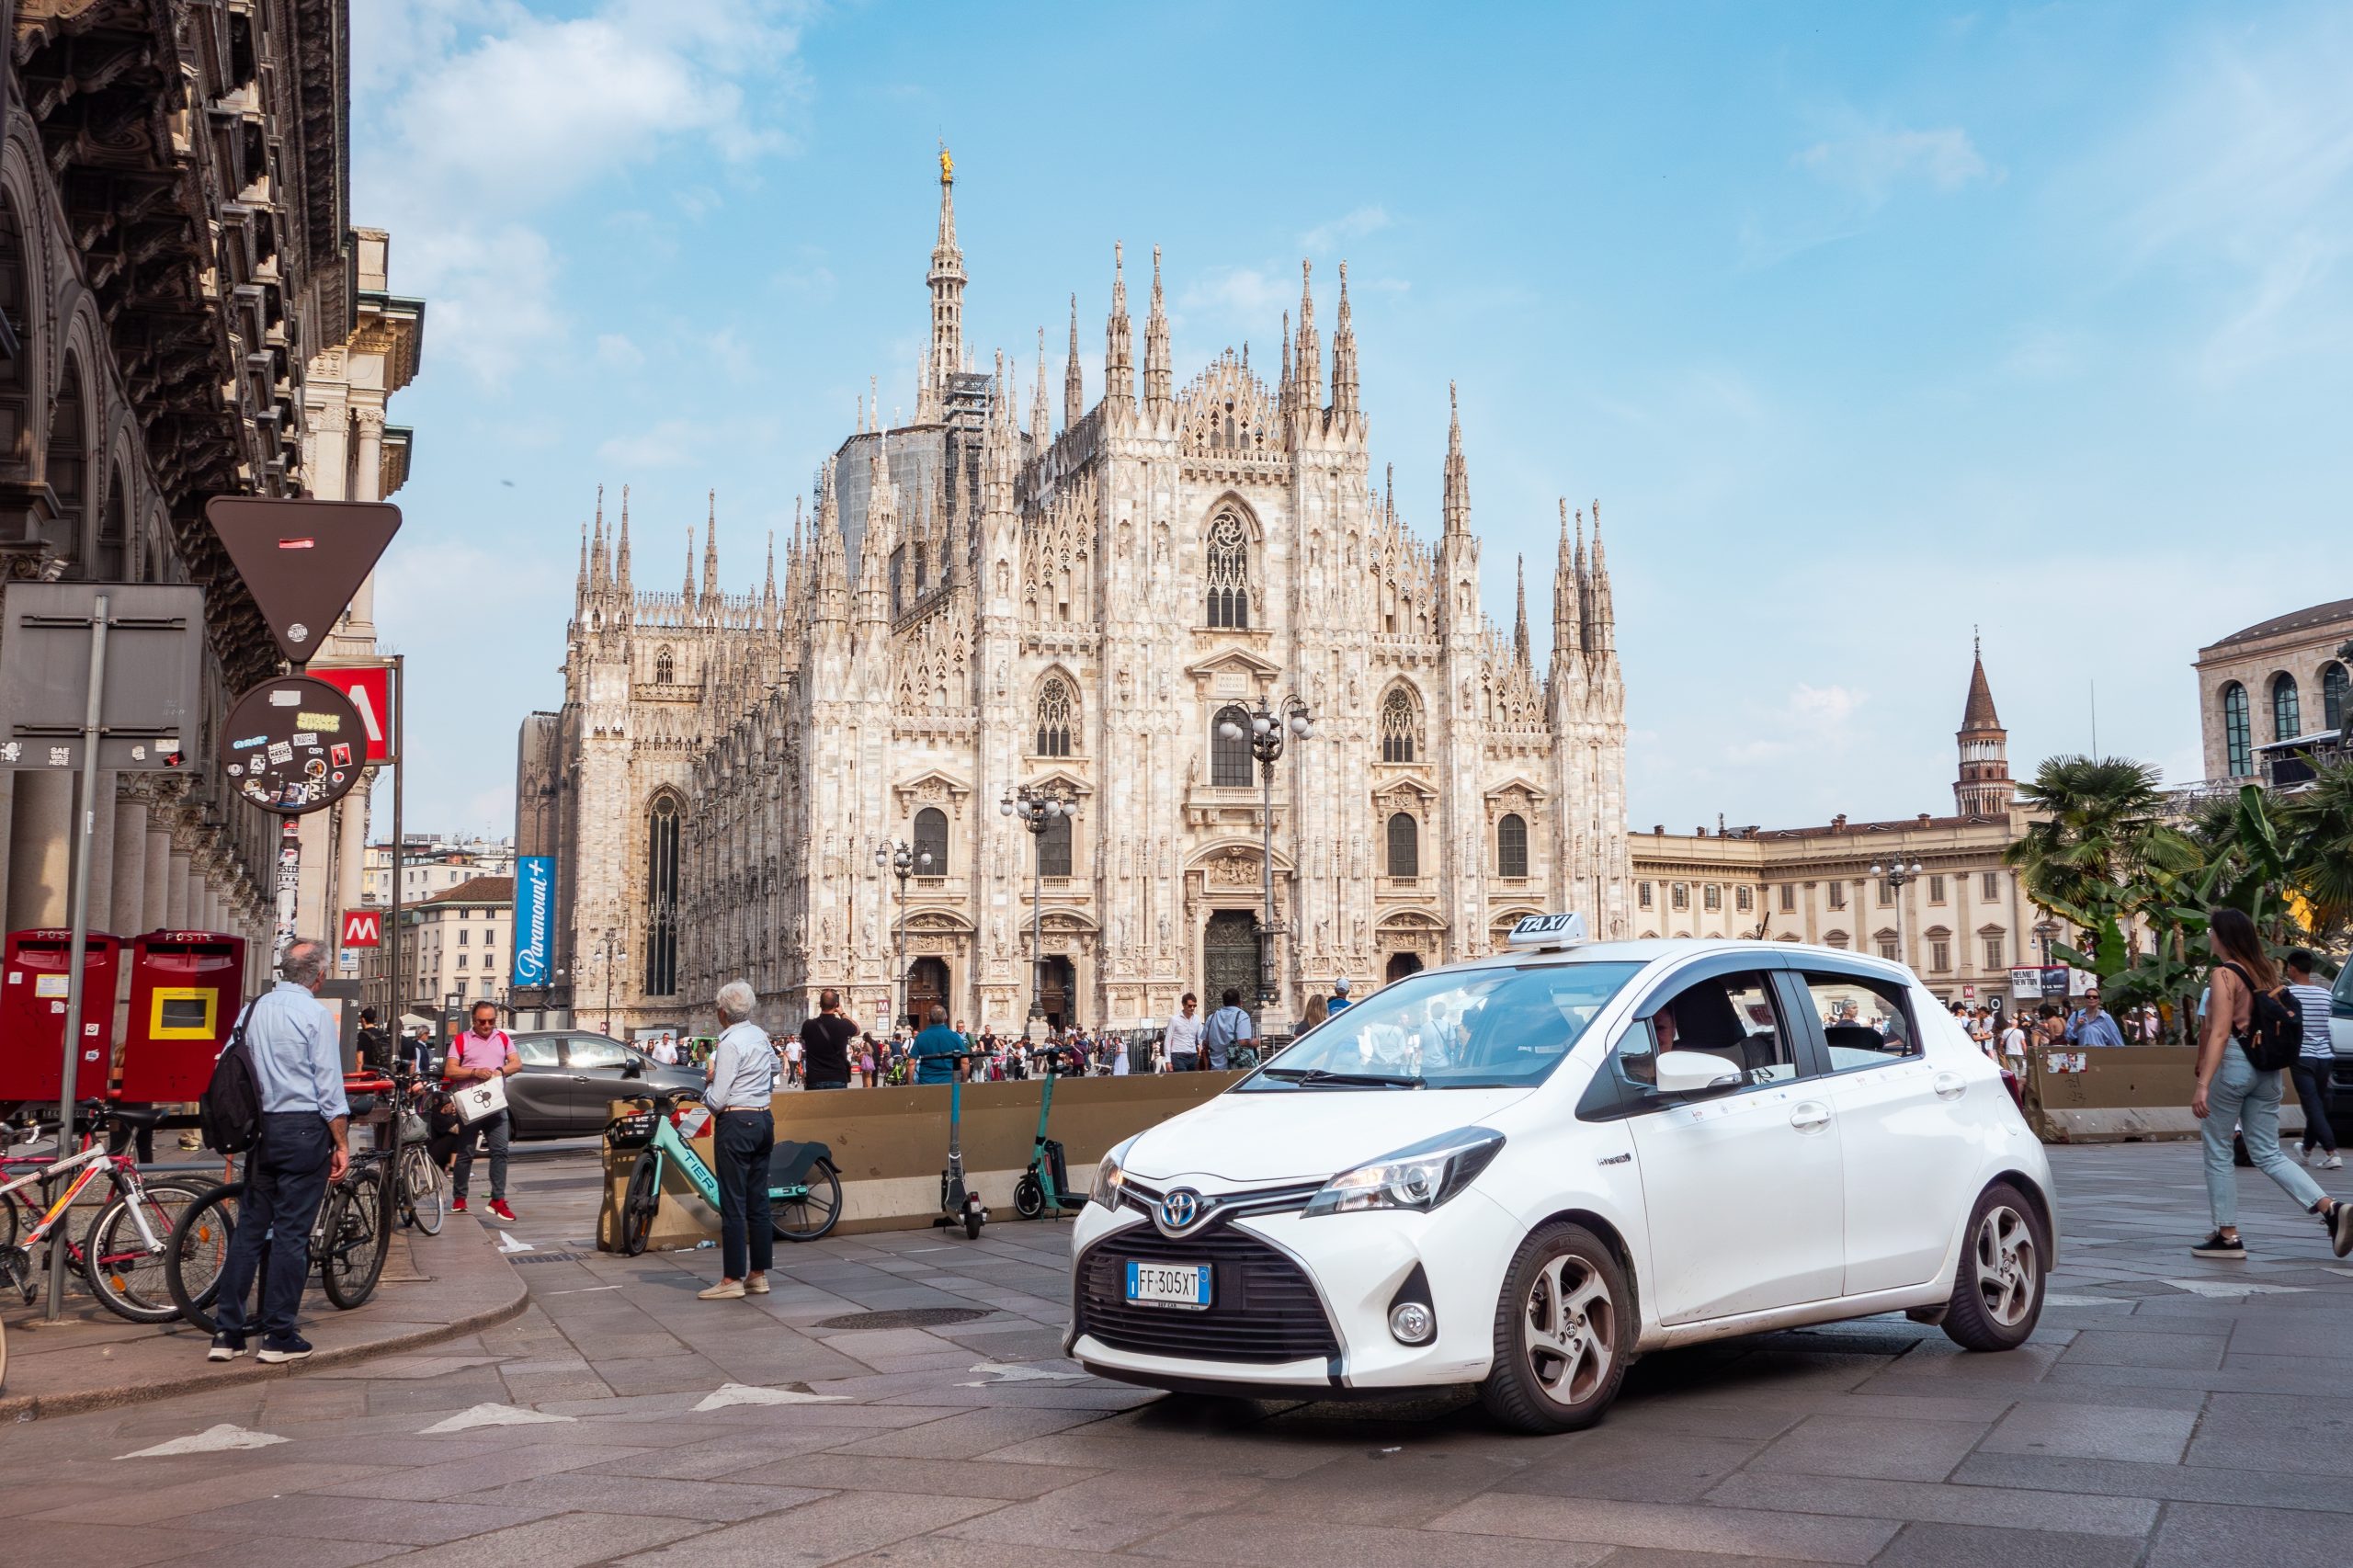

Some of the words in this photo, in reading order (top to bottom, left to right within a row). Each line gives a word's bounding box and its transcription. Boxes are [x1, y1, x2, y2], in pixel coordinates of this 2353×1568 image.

[50, 746, 70, 755] SAE
[517, 859, 548, 978] Paramount+
[346, 917, 378, 939] M
[1520, 915, 1569, 932] TAXI
[37, 931, 67, 939] POS
[165, 933, 213, 941] POSTE
[2013, 978, 2038, 986] NEWTON
[1964, 988, 1973, 996] M
[877, 1001, 889, 1011] M
[684, 1151, 715, 1191] TIER
